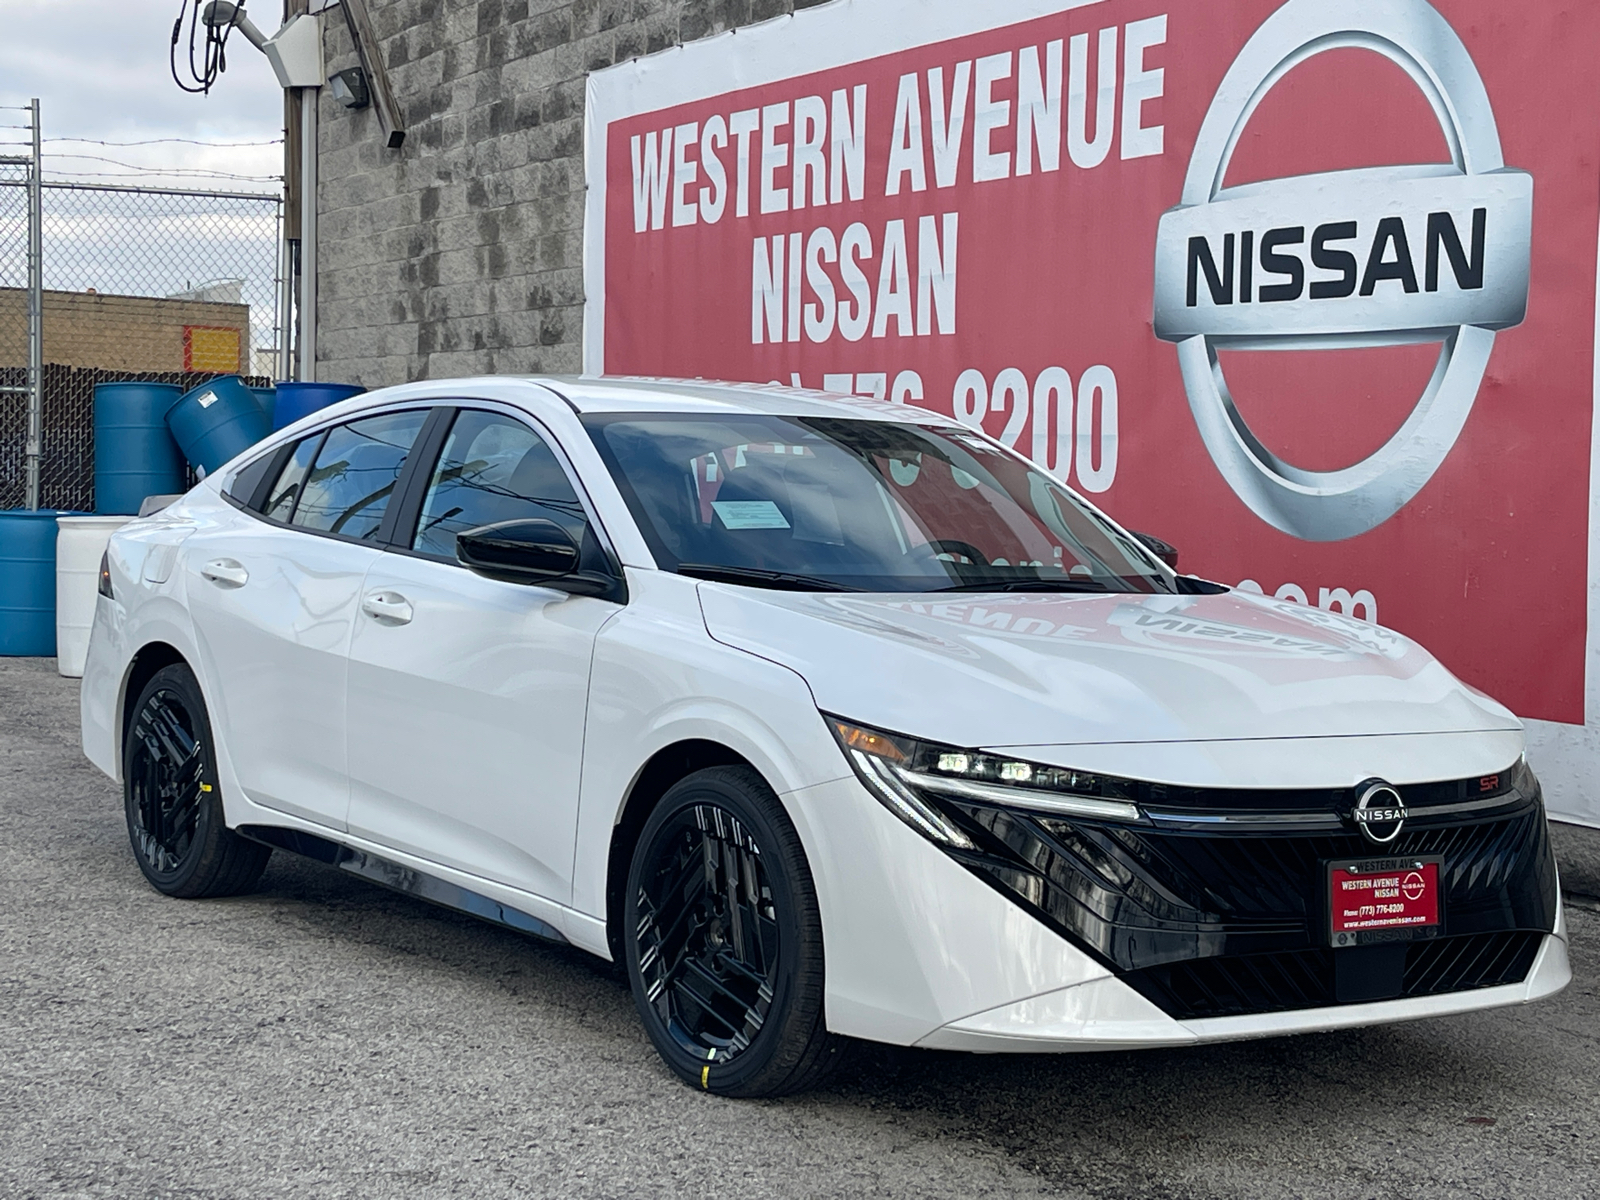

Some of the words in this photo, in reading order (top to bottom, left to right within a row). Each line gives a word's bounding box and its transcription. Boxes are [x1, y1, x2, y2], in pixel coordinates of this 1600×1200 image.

[631, 84, 867, 233] WESTERN
[885, 14, 1168, 196] AVENUE
[1186, 208, 1486, 307] NISSAN
[752, 212, 959, 344] NISSAN
[1480, 776, 1499, 791] SR
[1356, 808, 1408, 821] NISSAN
[1356, 859, 1397, 872] WESTERN
[1341, 879, 1372, 890] WESTERN
[1373, 877, 1400, 889] AVENUE
[1374, 888, 1400, 899] NISSAN
[1359, 905, 1375, 918] (773)
[1376, 903, 1404, 914] 776-8200
